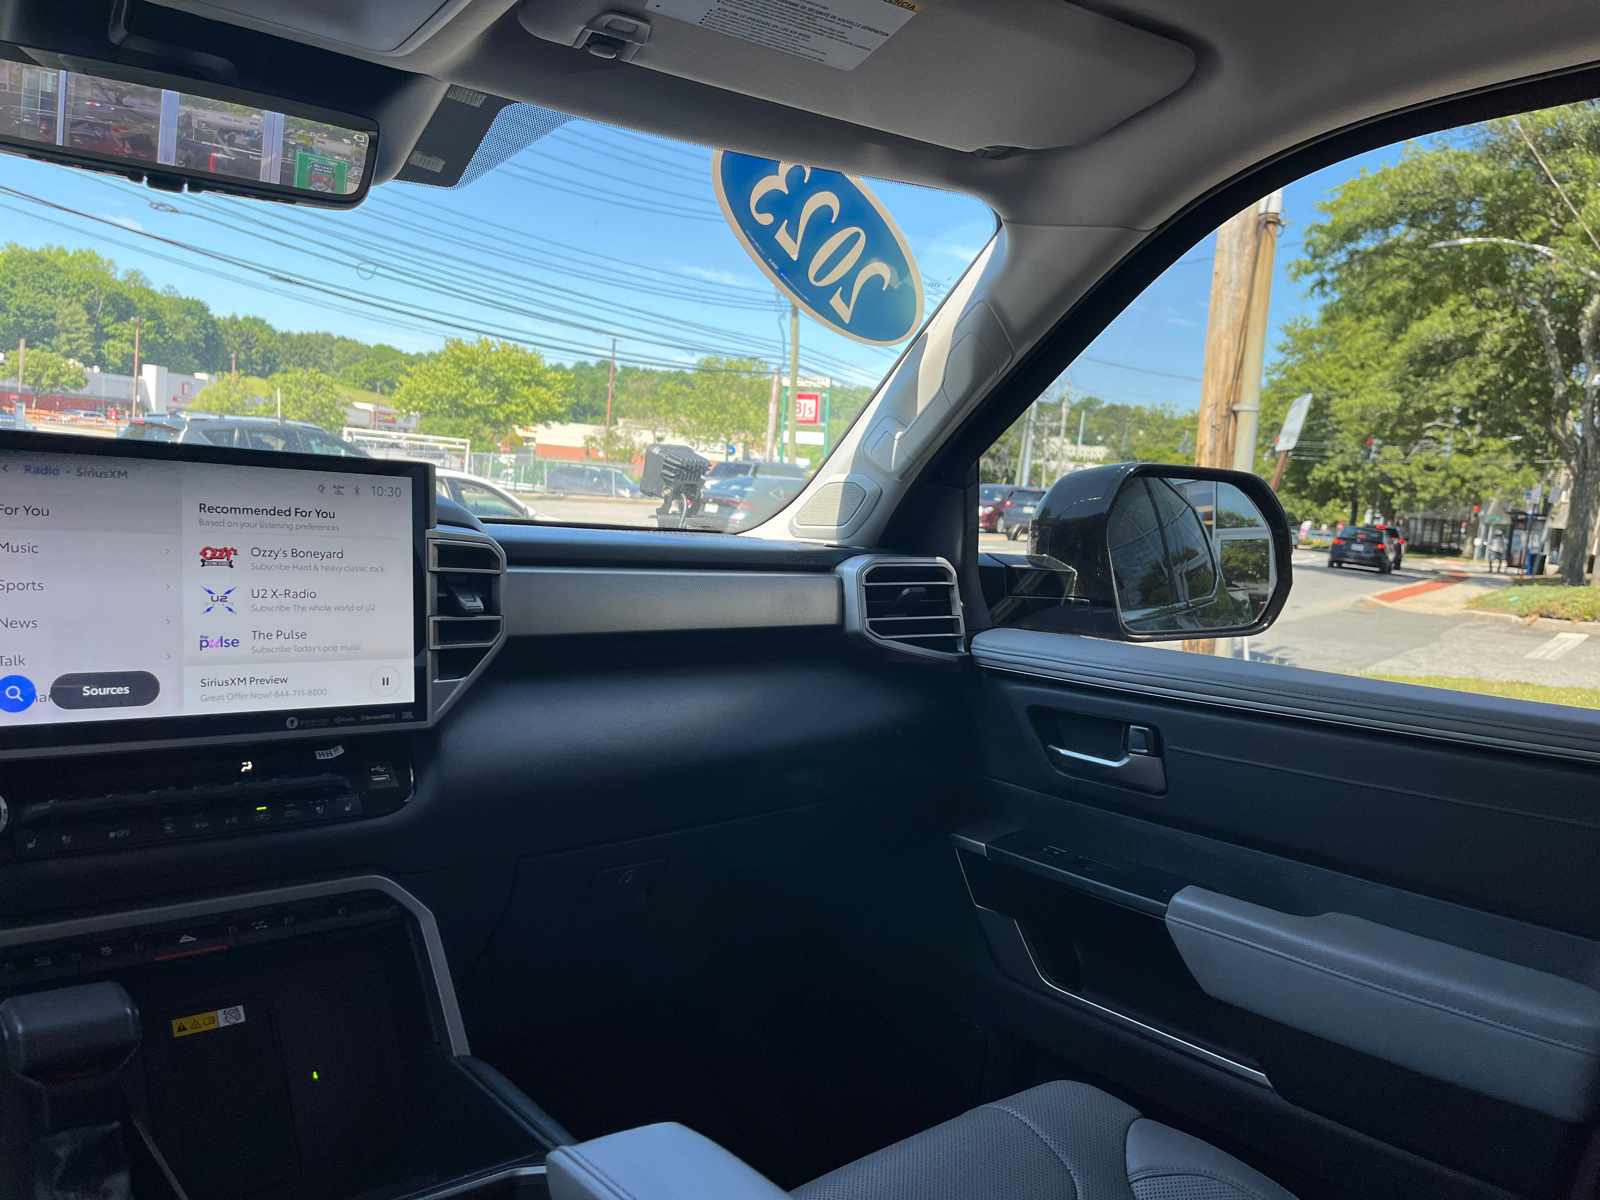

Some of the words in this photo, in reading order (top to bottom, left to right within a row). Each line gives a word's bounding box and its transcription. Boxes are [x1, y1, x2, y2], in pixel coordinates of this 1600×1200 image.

[24, 465, 60, 476] Radio
[76, 467, 128, 479] SiriusXM
[370, 485, 402, 497] 10:30
[23, 504, 50, 517] You
[198, 502, 292, 517] Recommended
[294, 507, 313, 518] For
[314, 508, 336, 519] You
[198, 518, 225, 527] Based
[239, 522, 258, 530] your
[259, 521, 294, 532] listening
[295, 523, 340, 532] preferences
[0, 541, 39, 554] Music
[250, 546, 288, 560] Ozzy's
[291, 548, 344, 561] Boneyard
[320, 564, 343, 573] heavy
[344, 564, 368, 572] classic
[369, 565, 385, 573] rock
[0, 579, 44, 593] Sports
[210, 595, 229, 603] U2
[251, 588, 268, 599] U2
[270, 588, 317, 599] X-Radio
[308, 604, 332, 612] whole
[333, 603, 355, 612] world
[355, 603, 364, 612] of
[365, 604, 376, 612] U2
[0, 617, 38, 629] News
[251, 630, 273, 641] The
[276, 630, 308, 640] Pulse
[199, 635, 240, 651] pulse
[323, 645, 339, 653] pop
[340, 643, 363, 652] music
[0, 654, 26, 667] Talk
[200, 677, 247, 688] SiriusXM
[249, 675, 289, 686] Preview
[82, 684, 130, 696] Sources
[200, 693, 225, 702] Great
[226, 691, 249, 701] Offer
[319, 749, 334, 758] HH
